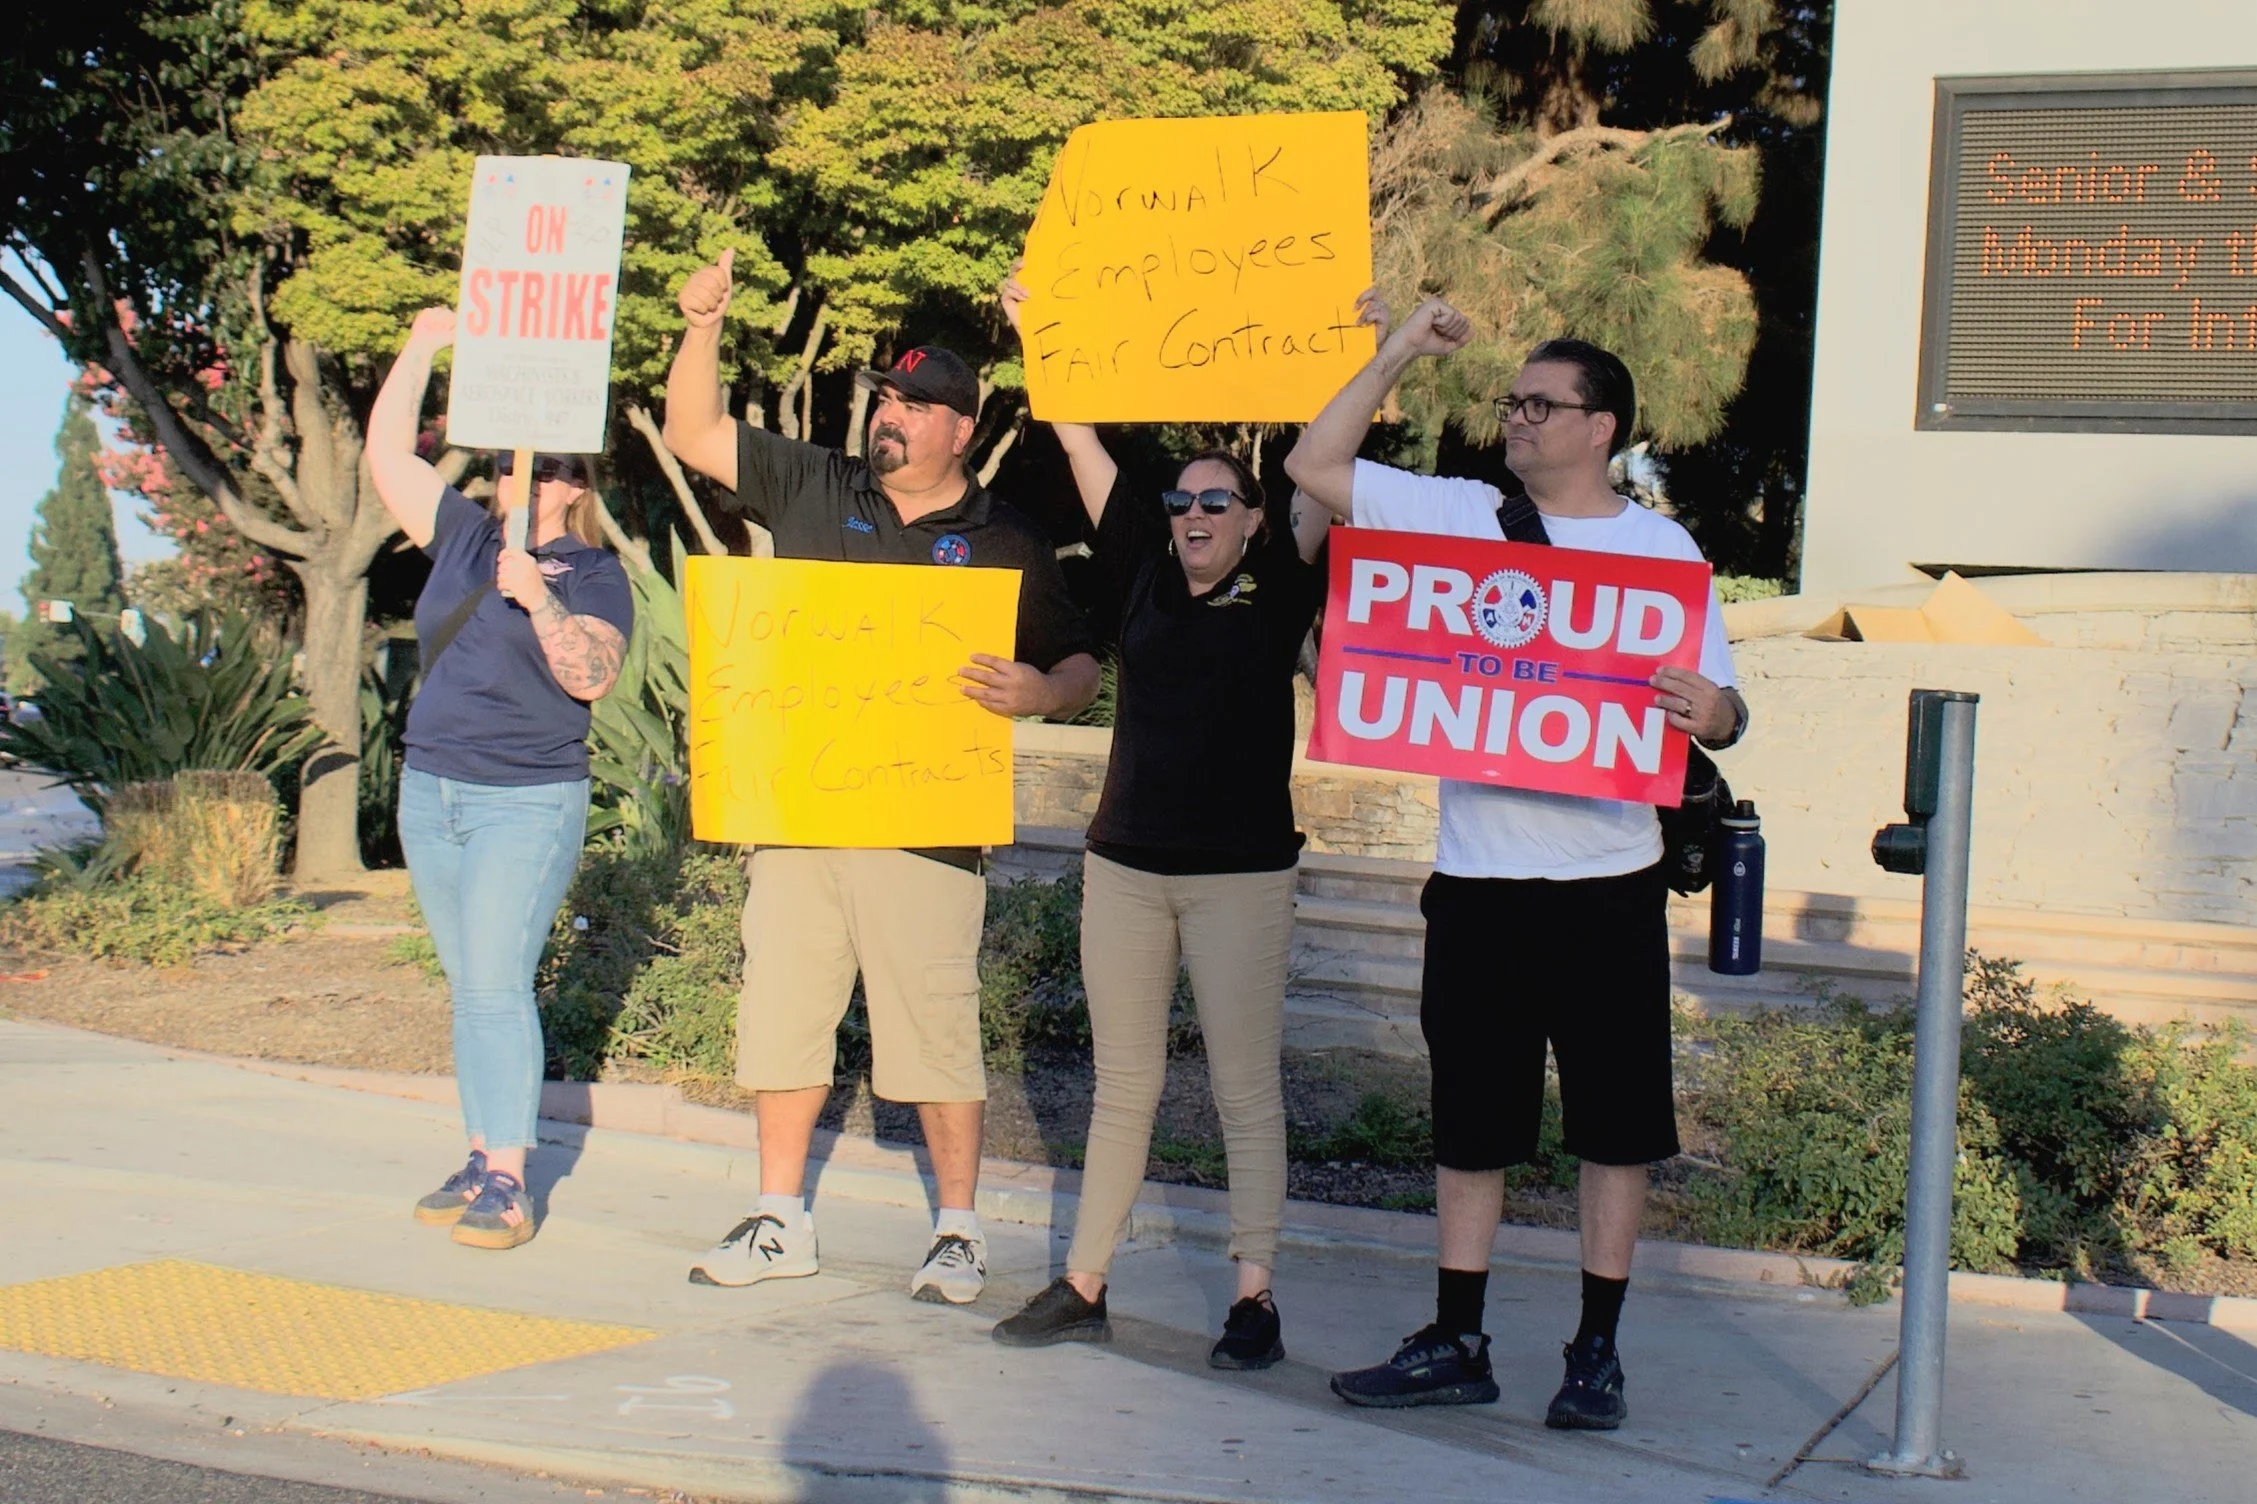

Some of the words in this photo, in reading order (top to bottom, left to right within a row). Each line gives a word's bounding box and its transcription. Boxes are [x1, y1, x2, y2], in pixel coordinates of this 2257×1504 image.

[1986, 151, 2160, 203] Senior
[2177, 149, 2222, 202] &
[524, 204, 568, 255] ON
[1981, 224, 2204, 290] Monday
[2224, 224, 2257, 276] t
[1050, 231, 1336, 302] Employees
[465, 268, 612, 341] STRIKE
[2072, 297, 2166, 350] For
[1158, 306, 1366, 369] Contract
[1457, 651, 1503, 677] TO
[1513, 660, 1561, 684] BE
[1337, 671, 1666, 775] UNION
[810, 728, 1006, 793] Contracts
